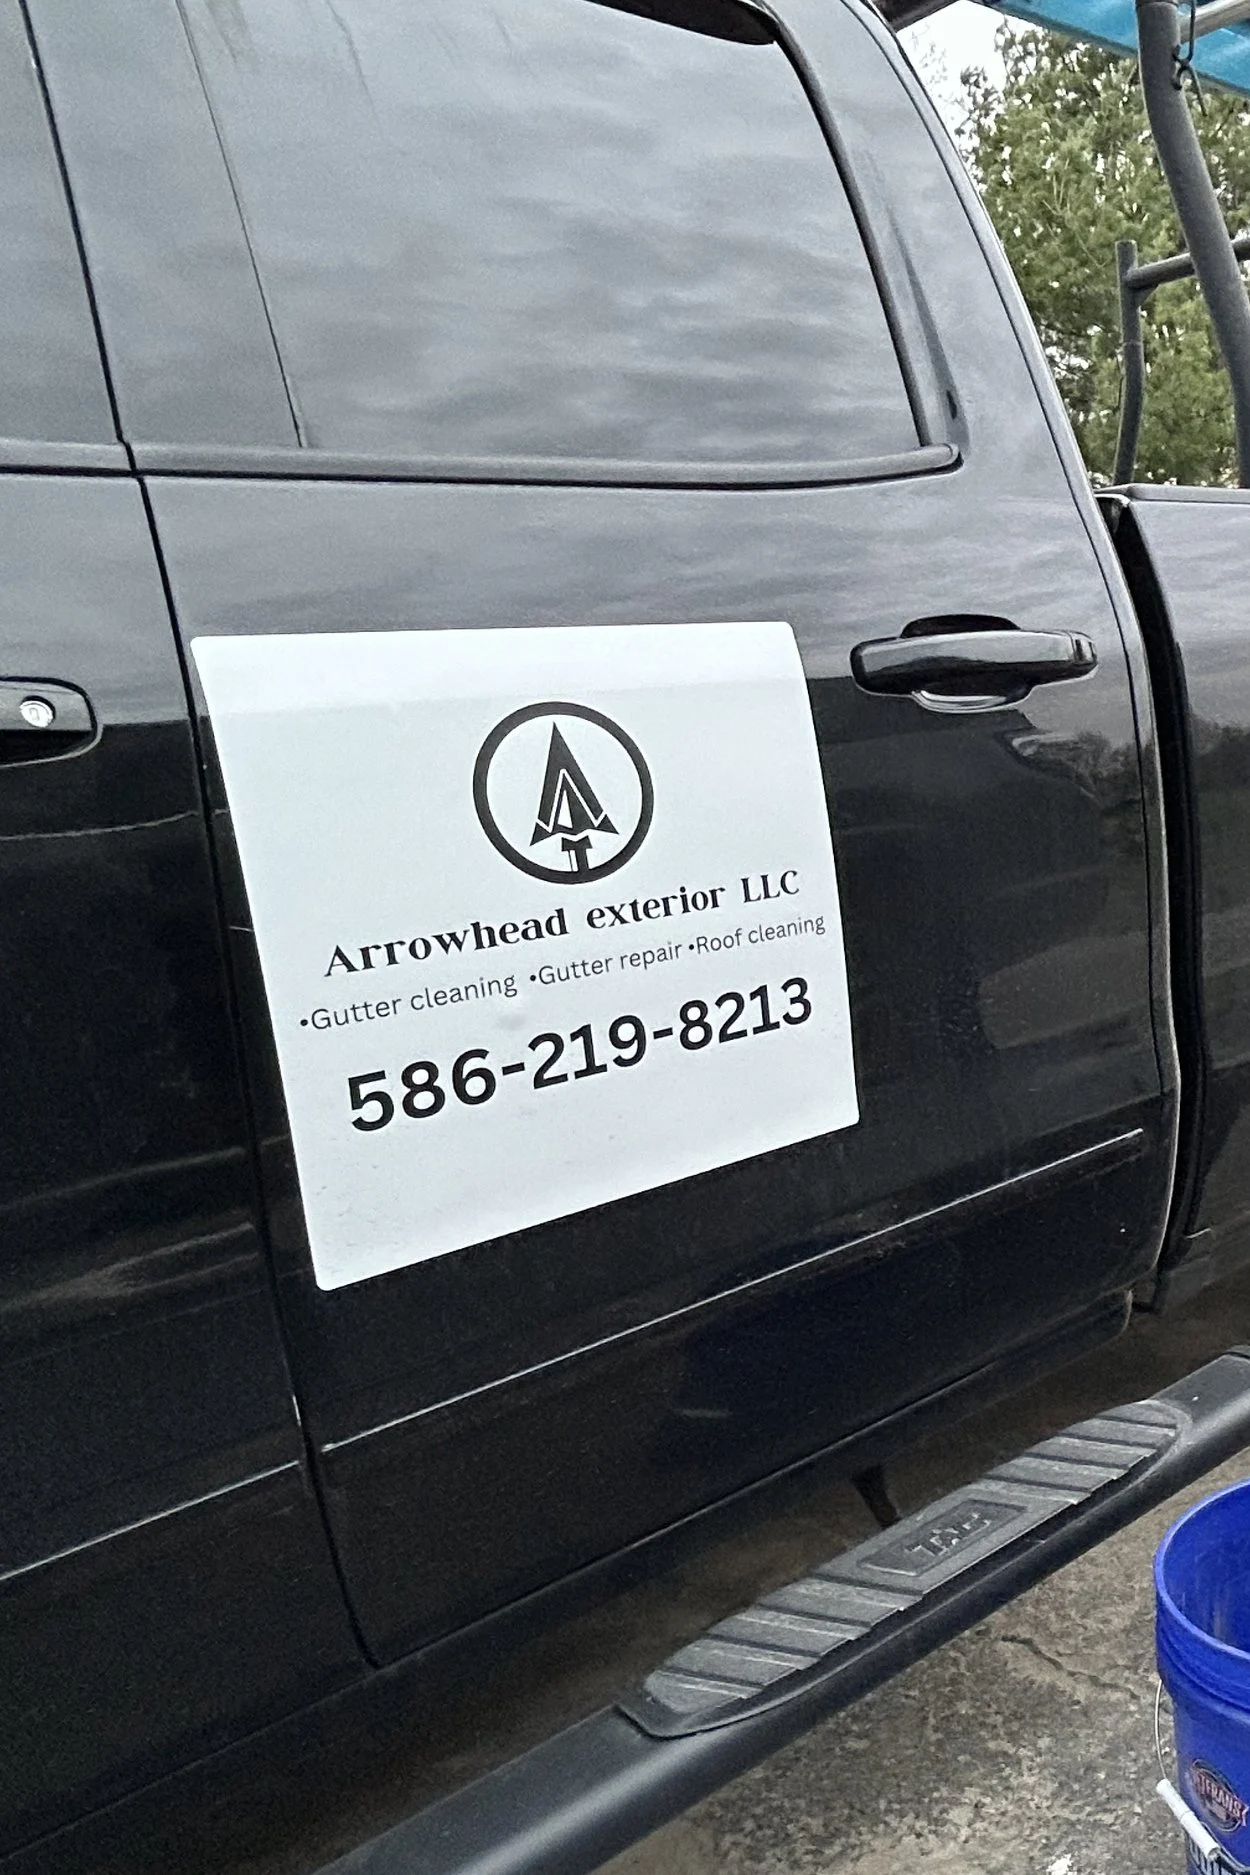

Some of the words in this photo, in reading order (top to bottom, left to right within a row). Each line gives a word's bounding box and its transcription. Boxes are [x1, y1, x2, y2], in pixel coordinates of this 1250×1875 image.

[324, 907, 569, 978] Arrowhead
[586, 886, 726, 929] exterior
[740, 870, 800, 904] LLC
[410, 973, 519, 1011] cleaning
[619, 941, 683, 970] repair
[748, 916, 827, 944] cleaning
[347, 976, 813, 1132] 586-219-8213
